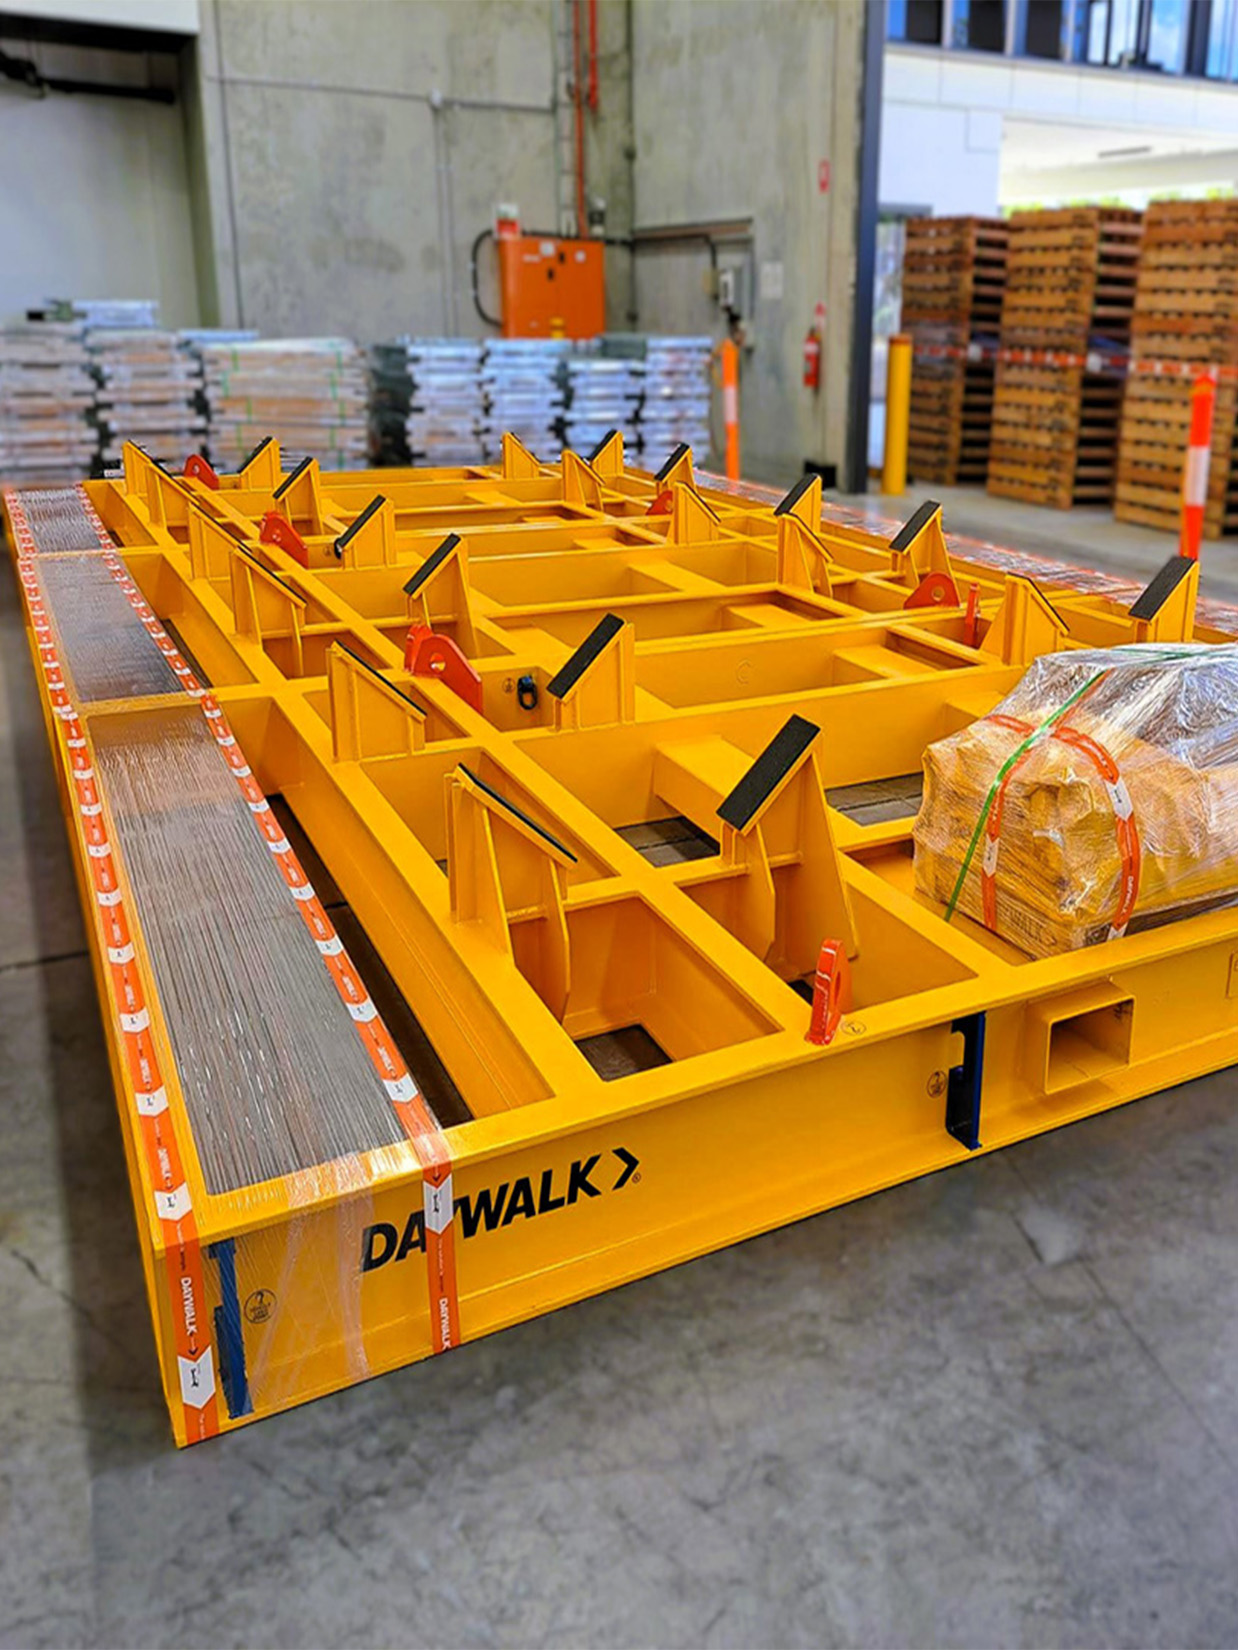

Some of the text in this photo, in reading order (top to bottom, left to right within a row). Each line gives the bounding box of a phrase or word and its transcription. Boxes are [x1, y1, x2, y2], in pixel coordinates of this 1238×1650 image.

[361, 1154, 601, 1272] DAWALK
[181, 1277, 197, 1335] DAYWALK
[440, 1298, 451, 1350] DAYWALK
